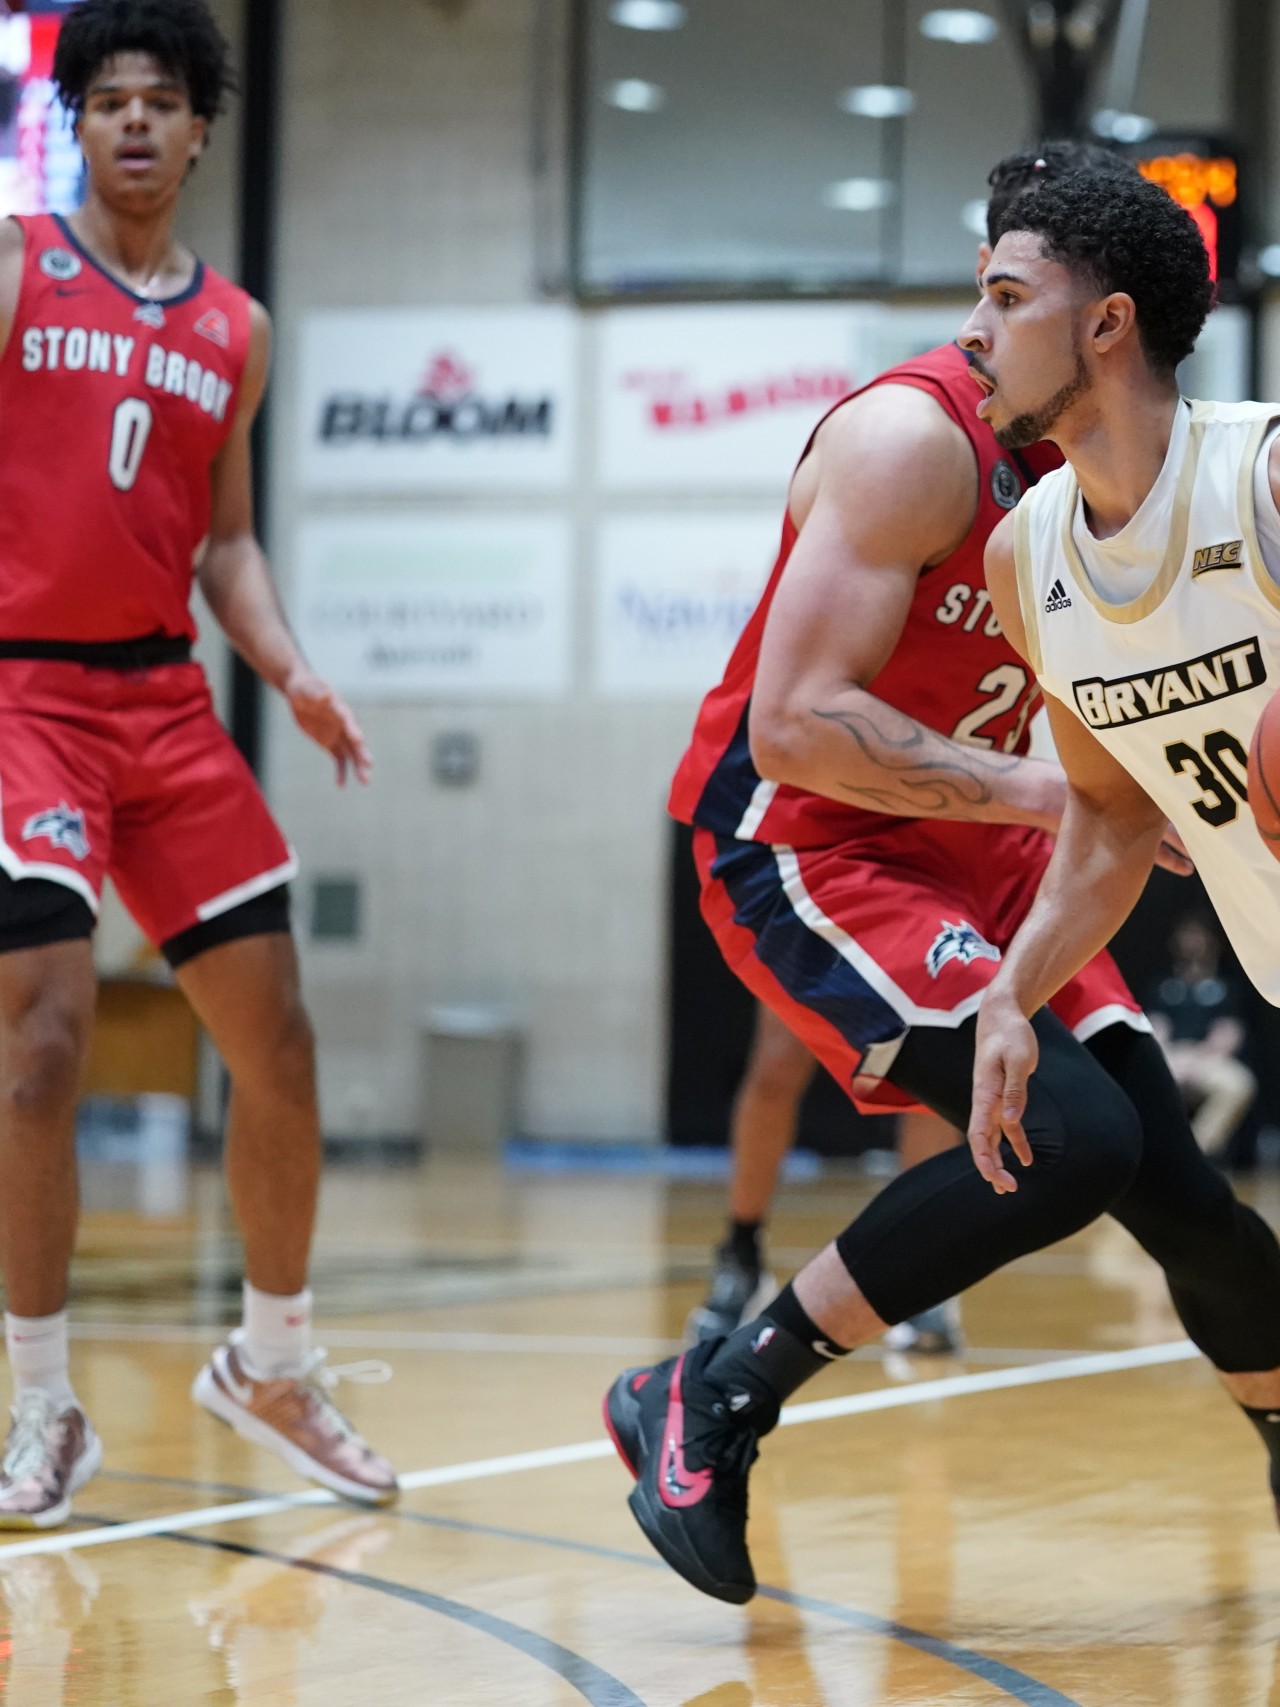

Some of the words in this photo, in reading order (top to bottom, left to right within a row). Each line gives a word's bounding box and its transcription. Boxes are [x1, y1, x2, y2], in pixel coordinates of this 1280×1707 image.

[22, 326, 134, 376] STONY
[145, 343, 233, 423] BROOK
[109, 397, 152, 491] 0
[318, 393, 555, 445] BLOOM
[1192, 540, 1243, 572] NEC
[1045, 599, 1072, 613] adidas
[1075, 642, 1256, 727] BRYANT
[1162, 728, 1248, 830] 30
